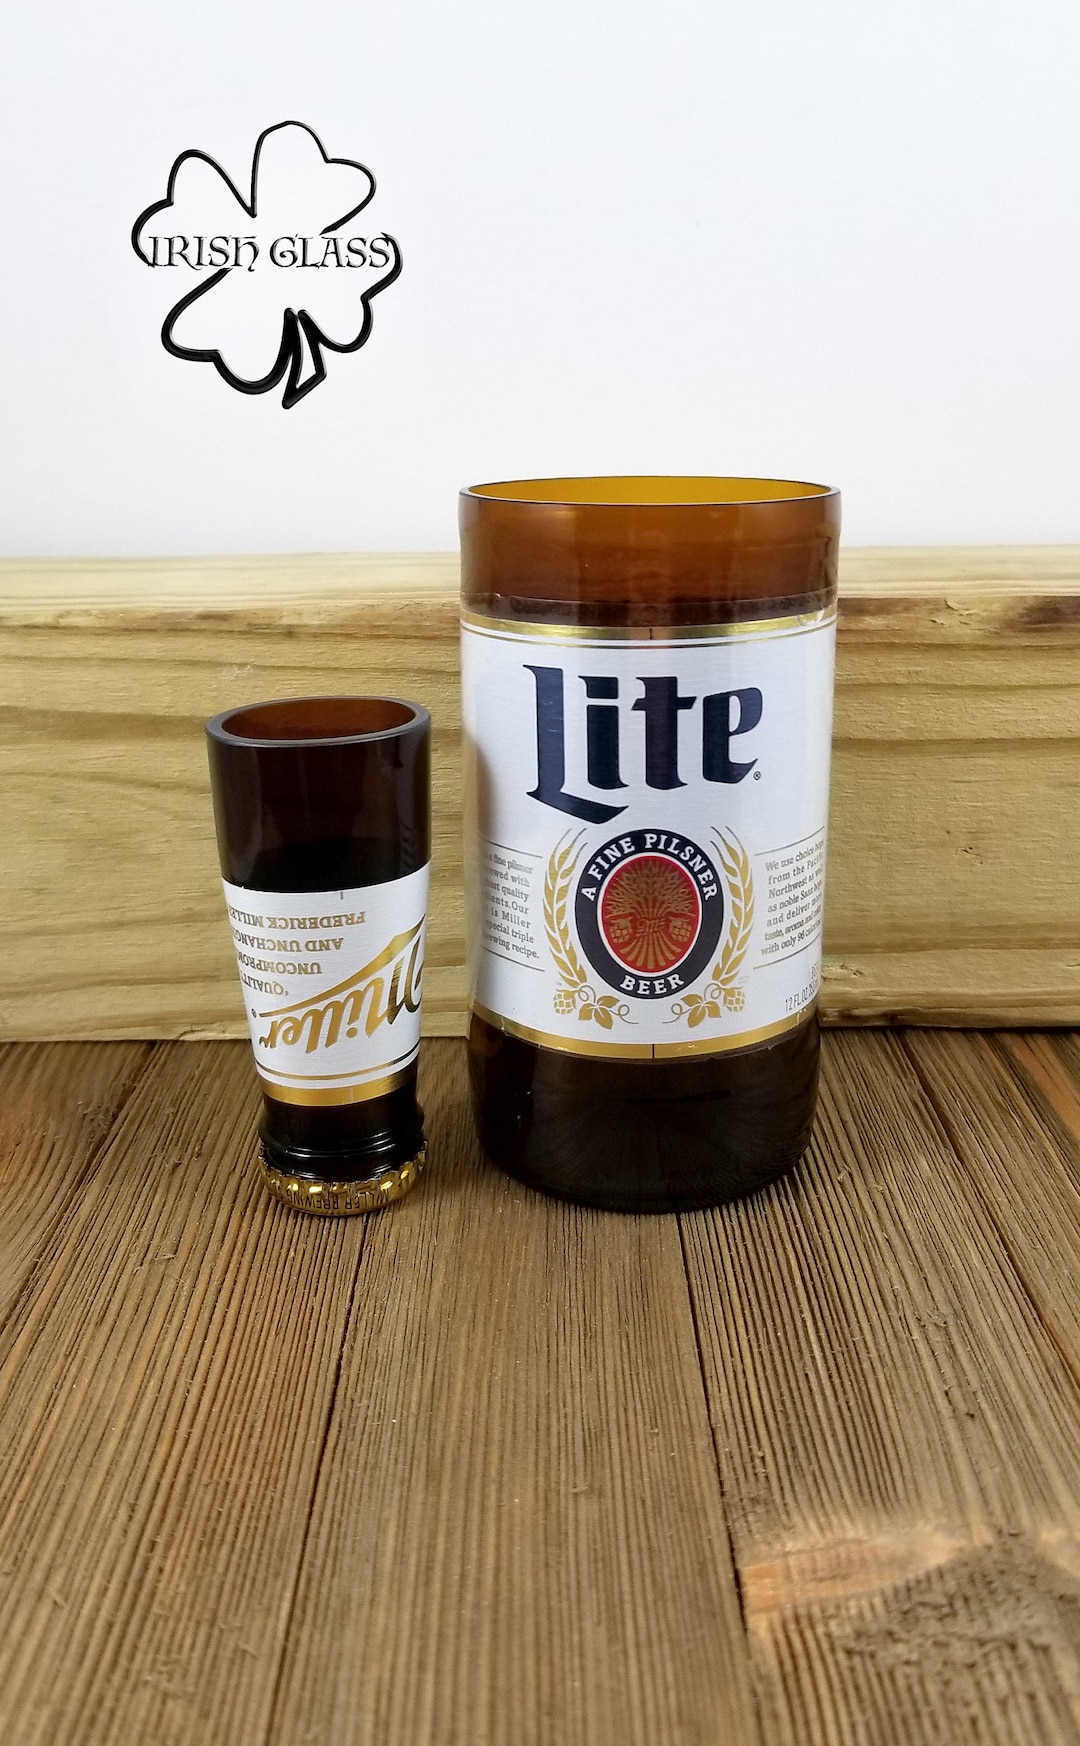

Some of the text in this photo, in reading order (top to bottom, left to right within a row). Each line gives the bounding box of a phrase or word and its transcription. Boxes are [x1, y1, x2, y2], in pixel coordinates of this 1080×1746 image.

[522, 664, 763, 825] Lite
[494, 853, 507, 866] fine
[507, 860, 533, 874] pilsner
[581, 833, 718, 901] A FINE PILSNER
[765, 861, 779, 873] We
[781, 856, 794, 868] use
[511, 874, 530, 888] with
[768, 872, 791, 886] from
[793, 865, 805, 877] the
[502, 886, 529, 902] quality
[768, 876, 808, 899] Northwest
[766, 913, 784, 927] and
[786, 901, 810, 920] deliver
[767, 903, 777, 913] as
[779, 895, 799, 910] noble
[265, 910, 367, 930] FREDERICK
[501, 910, 531, 929] Miller
[304, 937, 344, 951] AND
[511, 928, 534, 943] triple
[511, 942, 540, 958] recipe.
[760, 942, 779, 956] with
[237, 953, 323, 975] UNCOMPROM
[259, 933, 425, 1055] Miller
[619, 973, 684, 995] BEER
